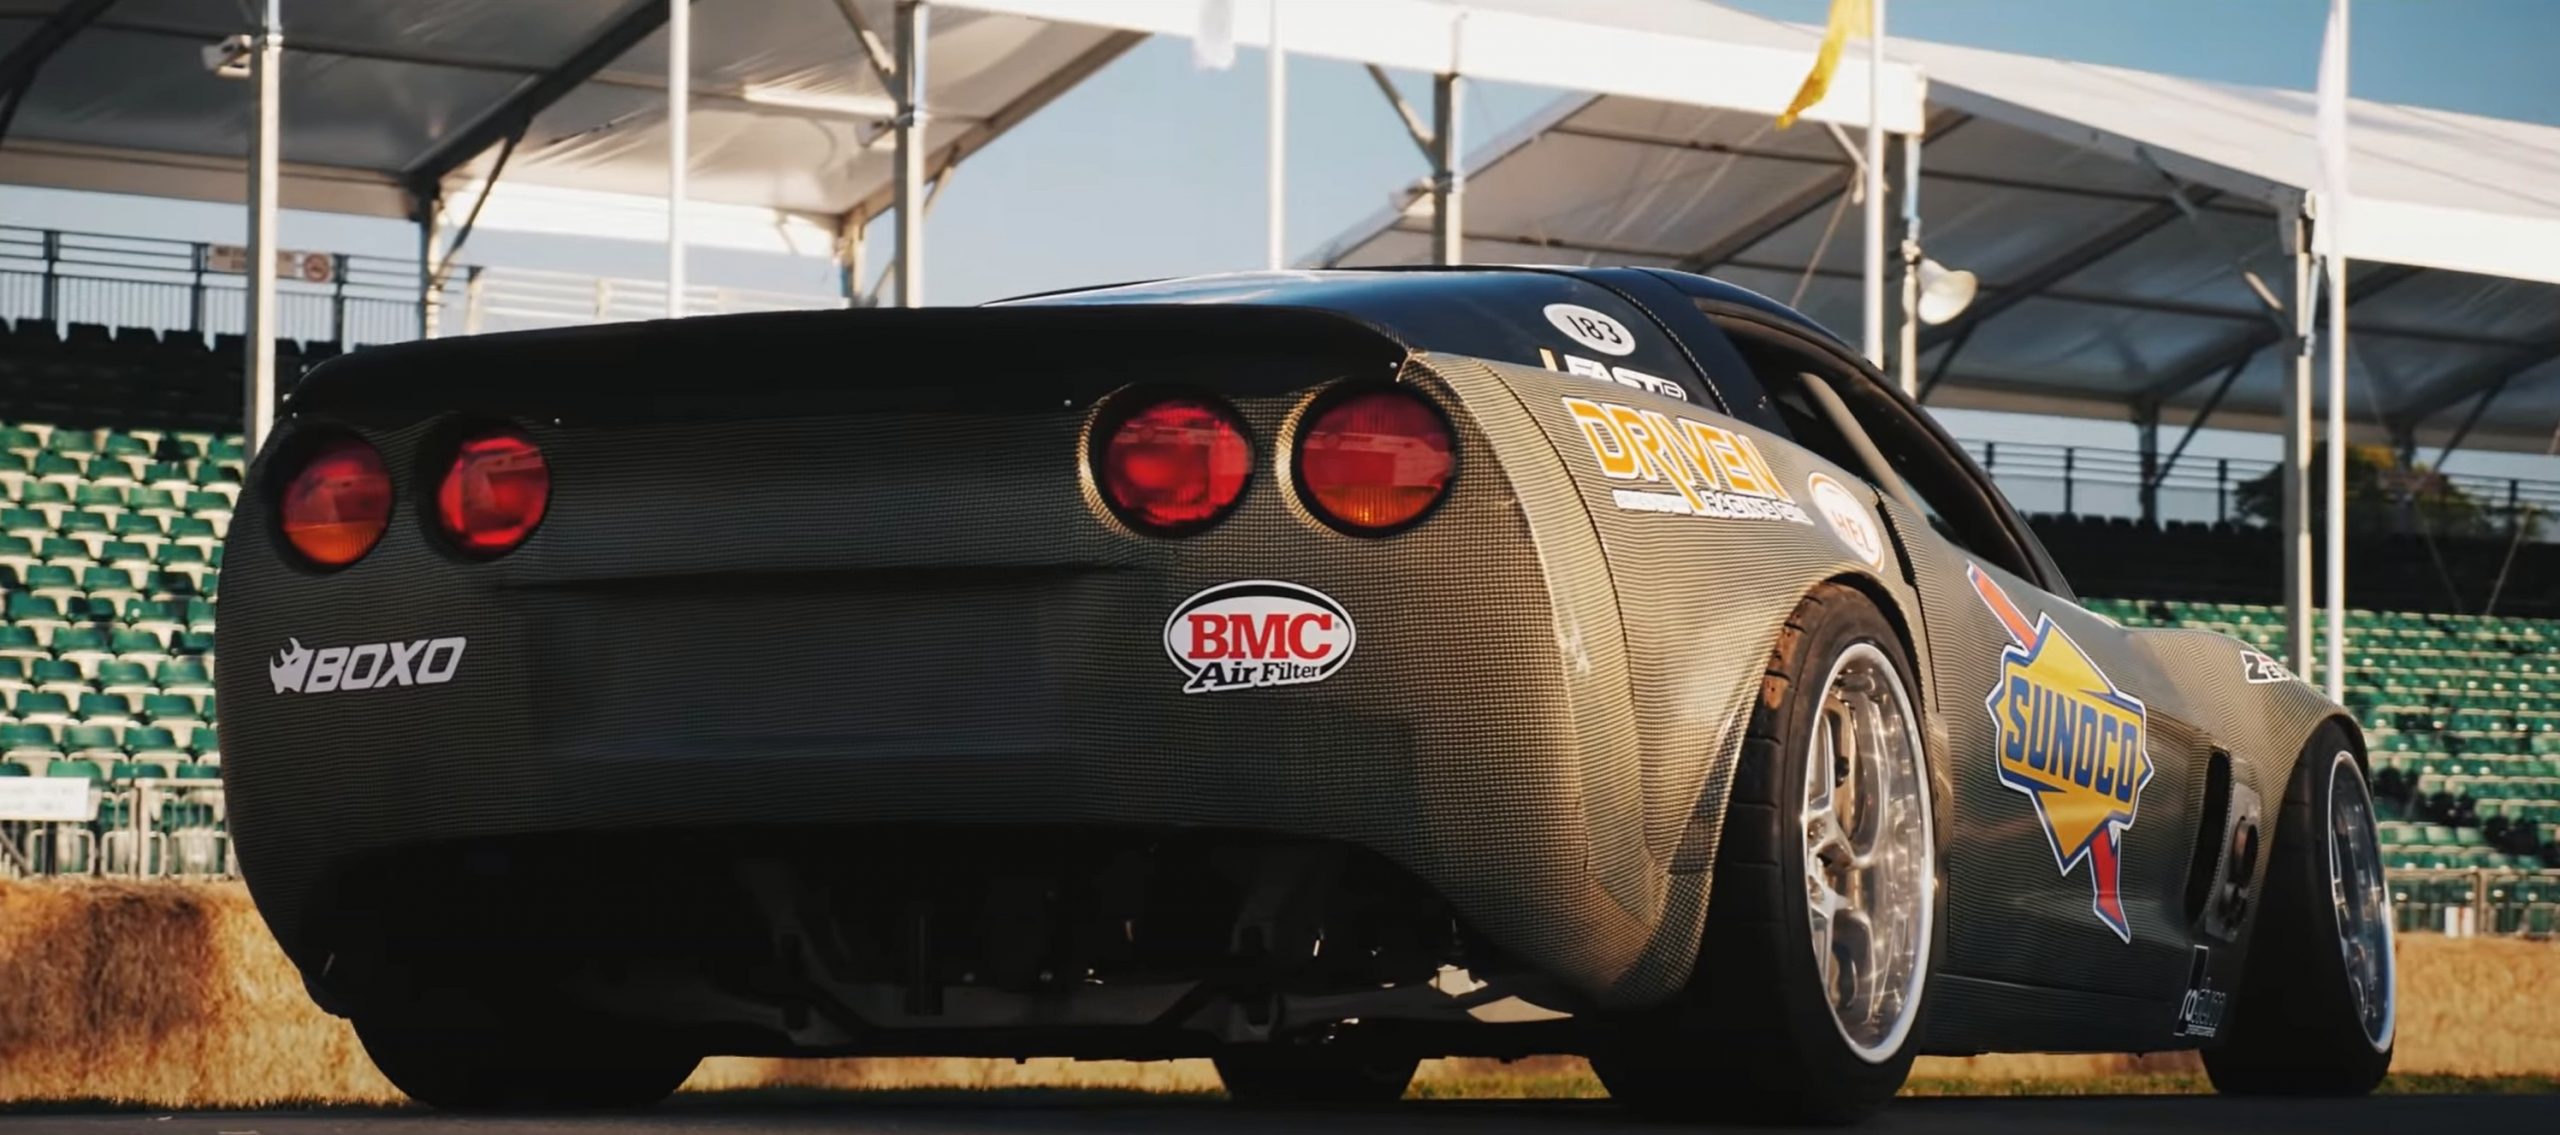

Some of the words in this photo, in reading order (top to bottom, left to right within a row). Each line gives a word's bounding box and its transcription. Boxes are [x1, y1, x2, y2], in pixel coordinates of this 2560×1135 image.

[1566, 315, 1622, 344] 183
[1562, 396, 1796, 513] DRIVEN
[1187, 613, 1332, 660] BMC
[304, 637, 467, 694] BOXO
[1186, 661, 1257, 690] Air
[1260, 661, 1319, 683] Filter
[2006, 674, 2137, 804] SUNOCO
